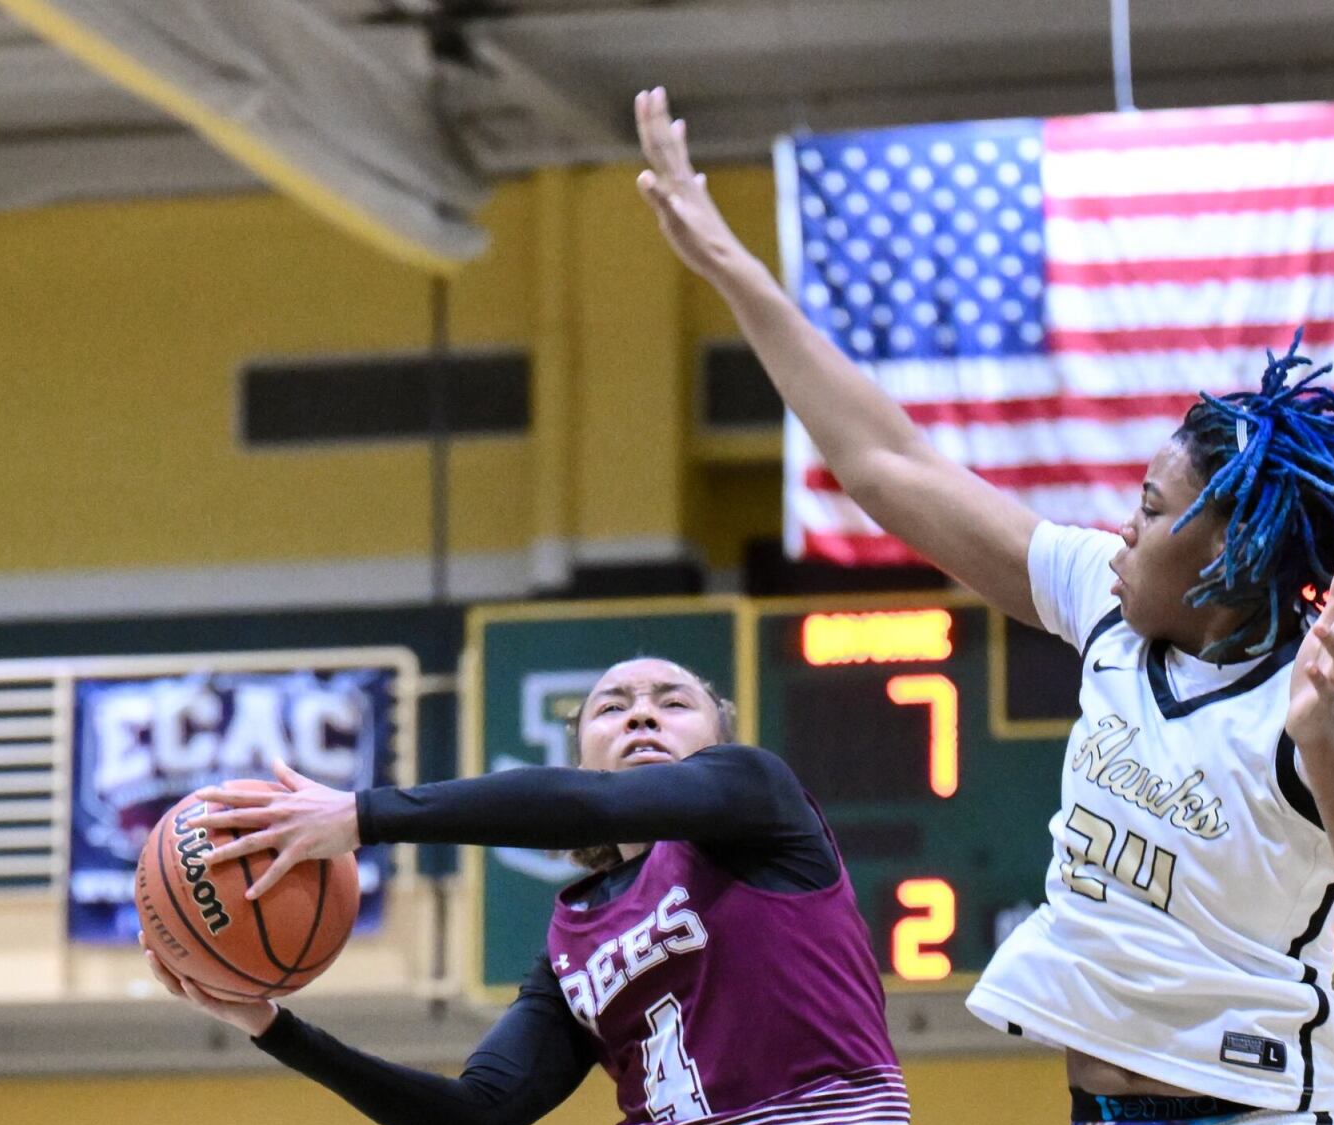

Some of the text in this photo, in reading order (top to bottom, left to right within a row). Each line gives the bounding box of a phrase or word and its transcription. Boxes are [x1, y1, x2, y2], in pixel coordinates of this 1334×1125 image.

[93, 680, 360, 790] ECAC
[888, 674, 958, 797] 7
[1072, 715, 1229, 839] Hawks
[173, 801, 232, 937] Wilson
[1061, 803, 1177, 911] 24
[559, 885, 709, 1028] BEES
[892, 877, 957, 981] 2
[640, 991, 712, 1123] 4
[1269, 1047, 1279, 1062] L
